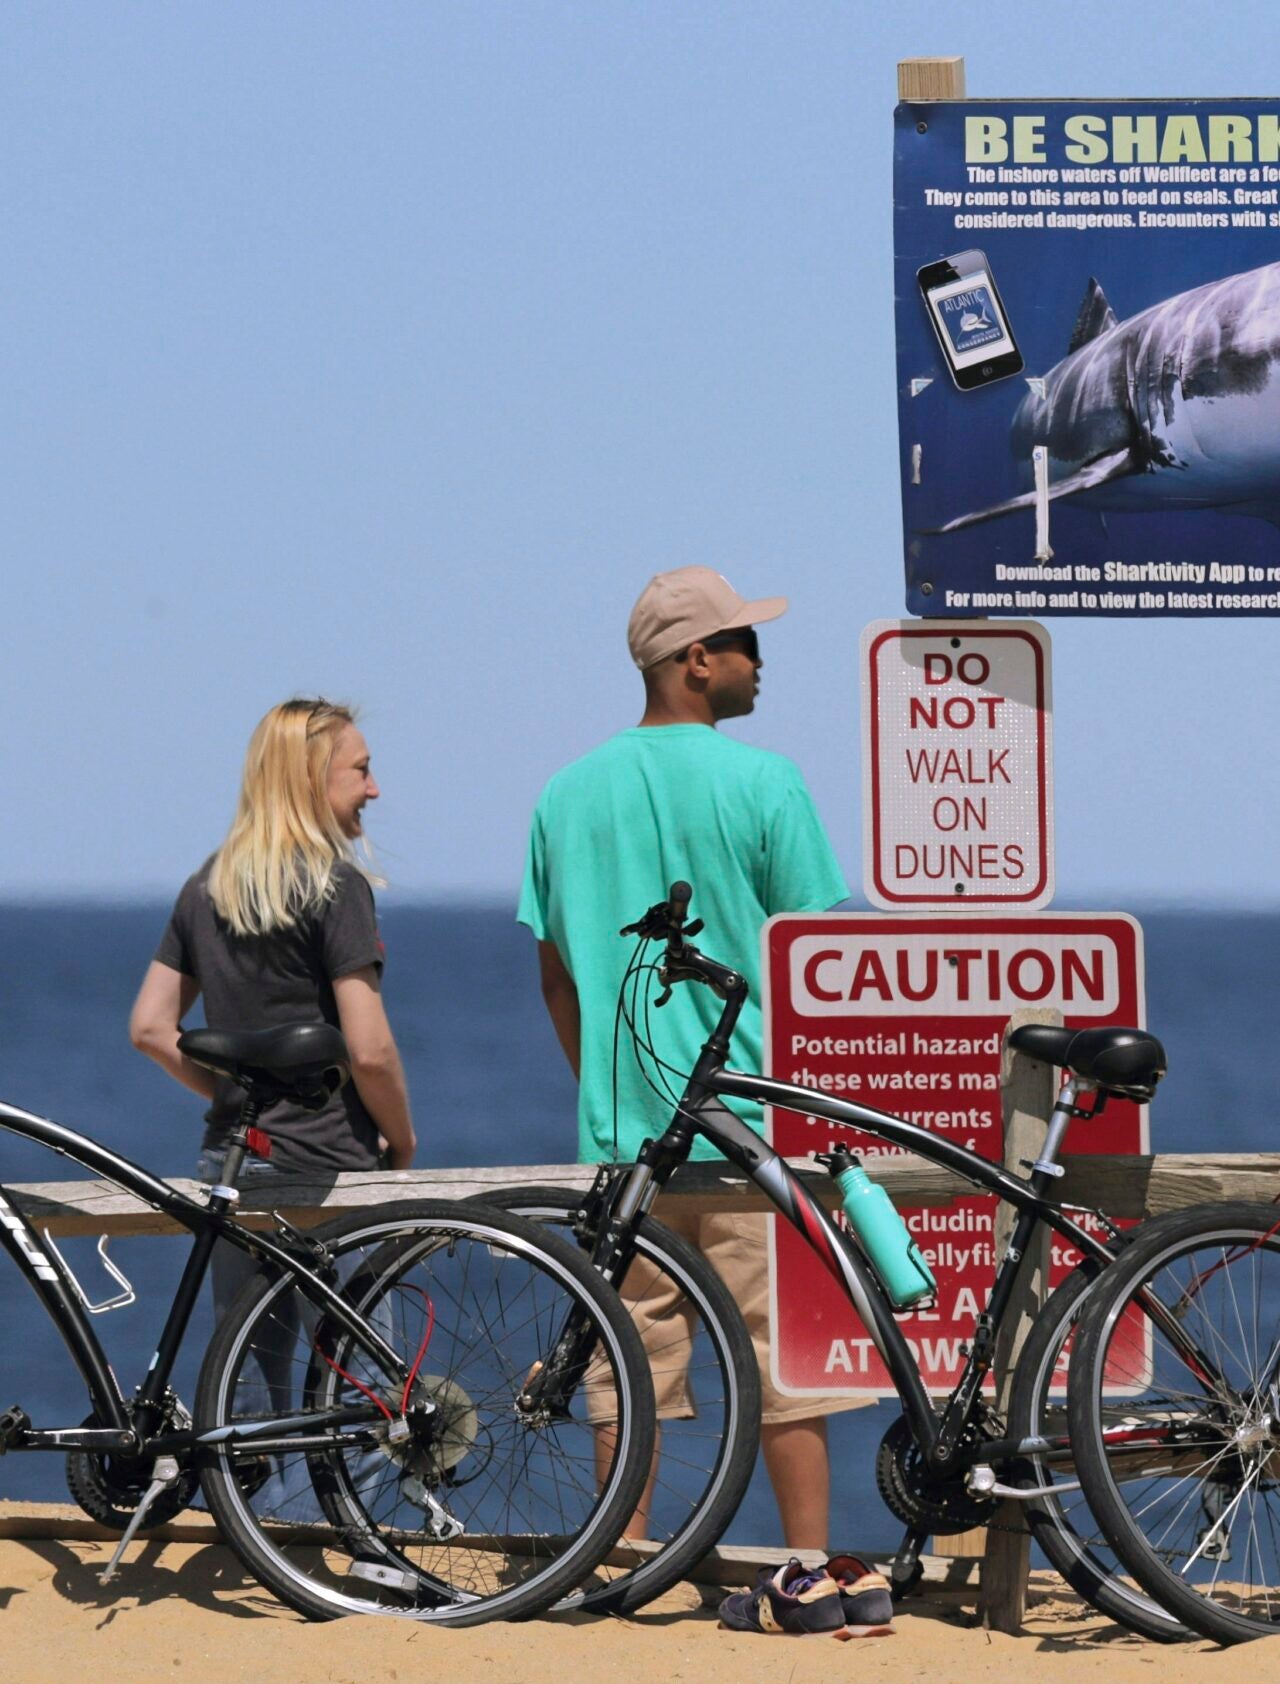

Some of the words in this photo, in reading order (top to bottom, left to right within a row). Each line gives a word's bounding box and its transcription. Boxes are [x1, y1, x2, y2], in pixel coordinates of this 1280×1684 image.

[966, 117, 1046, 163] BE
[967, 167, 995, 183] The
[999, 167, 1058, 183] inshore
[1061, 168, 1116, 183] waters
[1120, 167, 1141, 182] off
[1144, 166, 1216, 182] Wellfleet
[1219, 169, 1246, 182] are
[1250, 169, 1259, 182] a
[925, 189, 962, 207] They
[965, 192, 1008, 205] come
[1011, 191, 1027, 205] to
[1030, 189, 1060, 205] this
[1064, 192, 1100, 205] area
[1103, 190, 1119, 205] to
[1122, 189, 1157, 205] feed
[1161, 192, 1180, 205] on
[1184, 189, 1231, 204] seals.
[1234, 189, 1277, 204] Great
[955, 212, 1043, 228] considered
[1047, 212, 1136, 229] dangerous.
[1139, 211, 1228, 227] Encounters
[1232, 211, 1266, 226] with
[944, 289, 985, 313] ATLANTIC
[996, 565, 1072, 580] Download
[1075, 566, 1100, 581] the
[1104, 562, 1205, 583] Sharktivity
[1209, 563, 1245, 583] App
[1248, 566, 1264, 581] to
[946, 591, 970, 607] For
[973, 594, 1012, 606] more
[1016, 591, 1046, 607] info
[1049, 592, 1078, 607] and
[1081, 593, 1097, 608] to
[1100, 592, 1136, 608] view
[1139, 592, 1164, 608] the
[1168, 592, 1213, 608] latest
[924, 653, 990, 685] DO
[910, 697, 1004, 729] NOT
[906, 749, 1011, 783] WALK
[933, 797, 987, 831] ON
[895, 845, 1024, 879] DUNES
[804, 949, 1104, 1001] CAUTION
[791, 1034, 905, 1055] Potential
[914, 1033, 999, 1055] hazard
[791, 1069, 861, 1090] these
[867, 1070, 952, 1090] waters
[888, 1108, 992, 1128] urrents
[824, 1338, 874, 1373] AT
